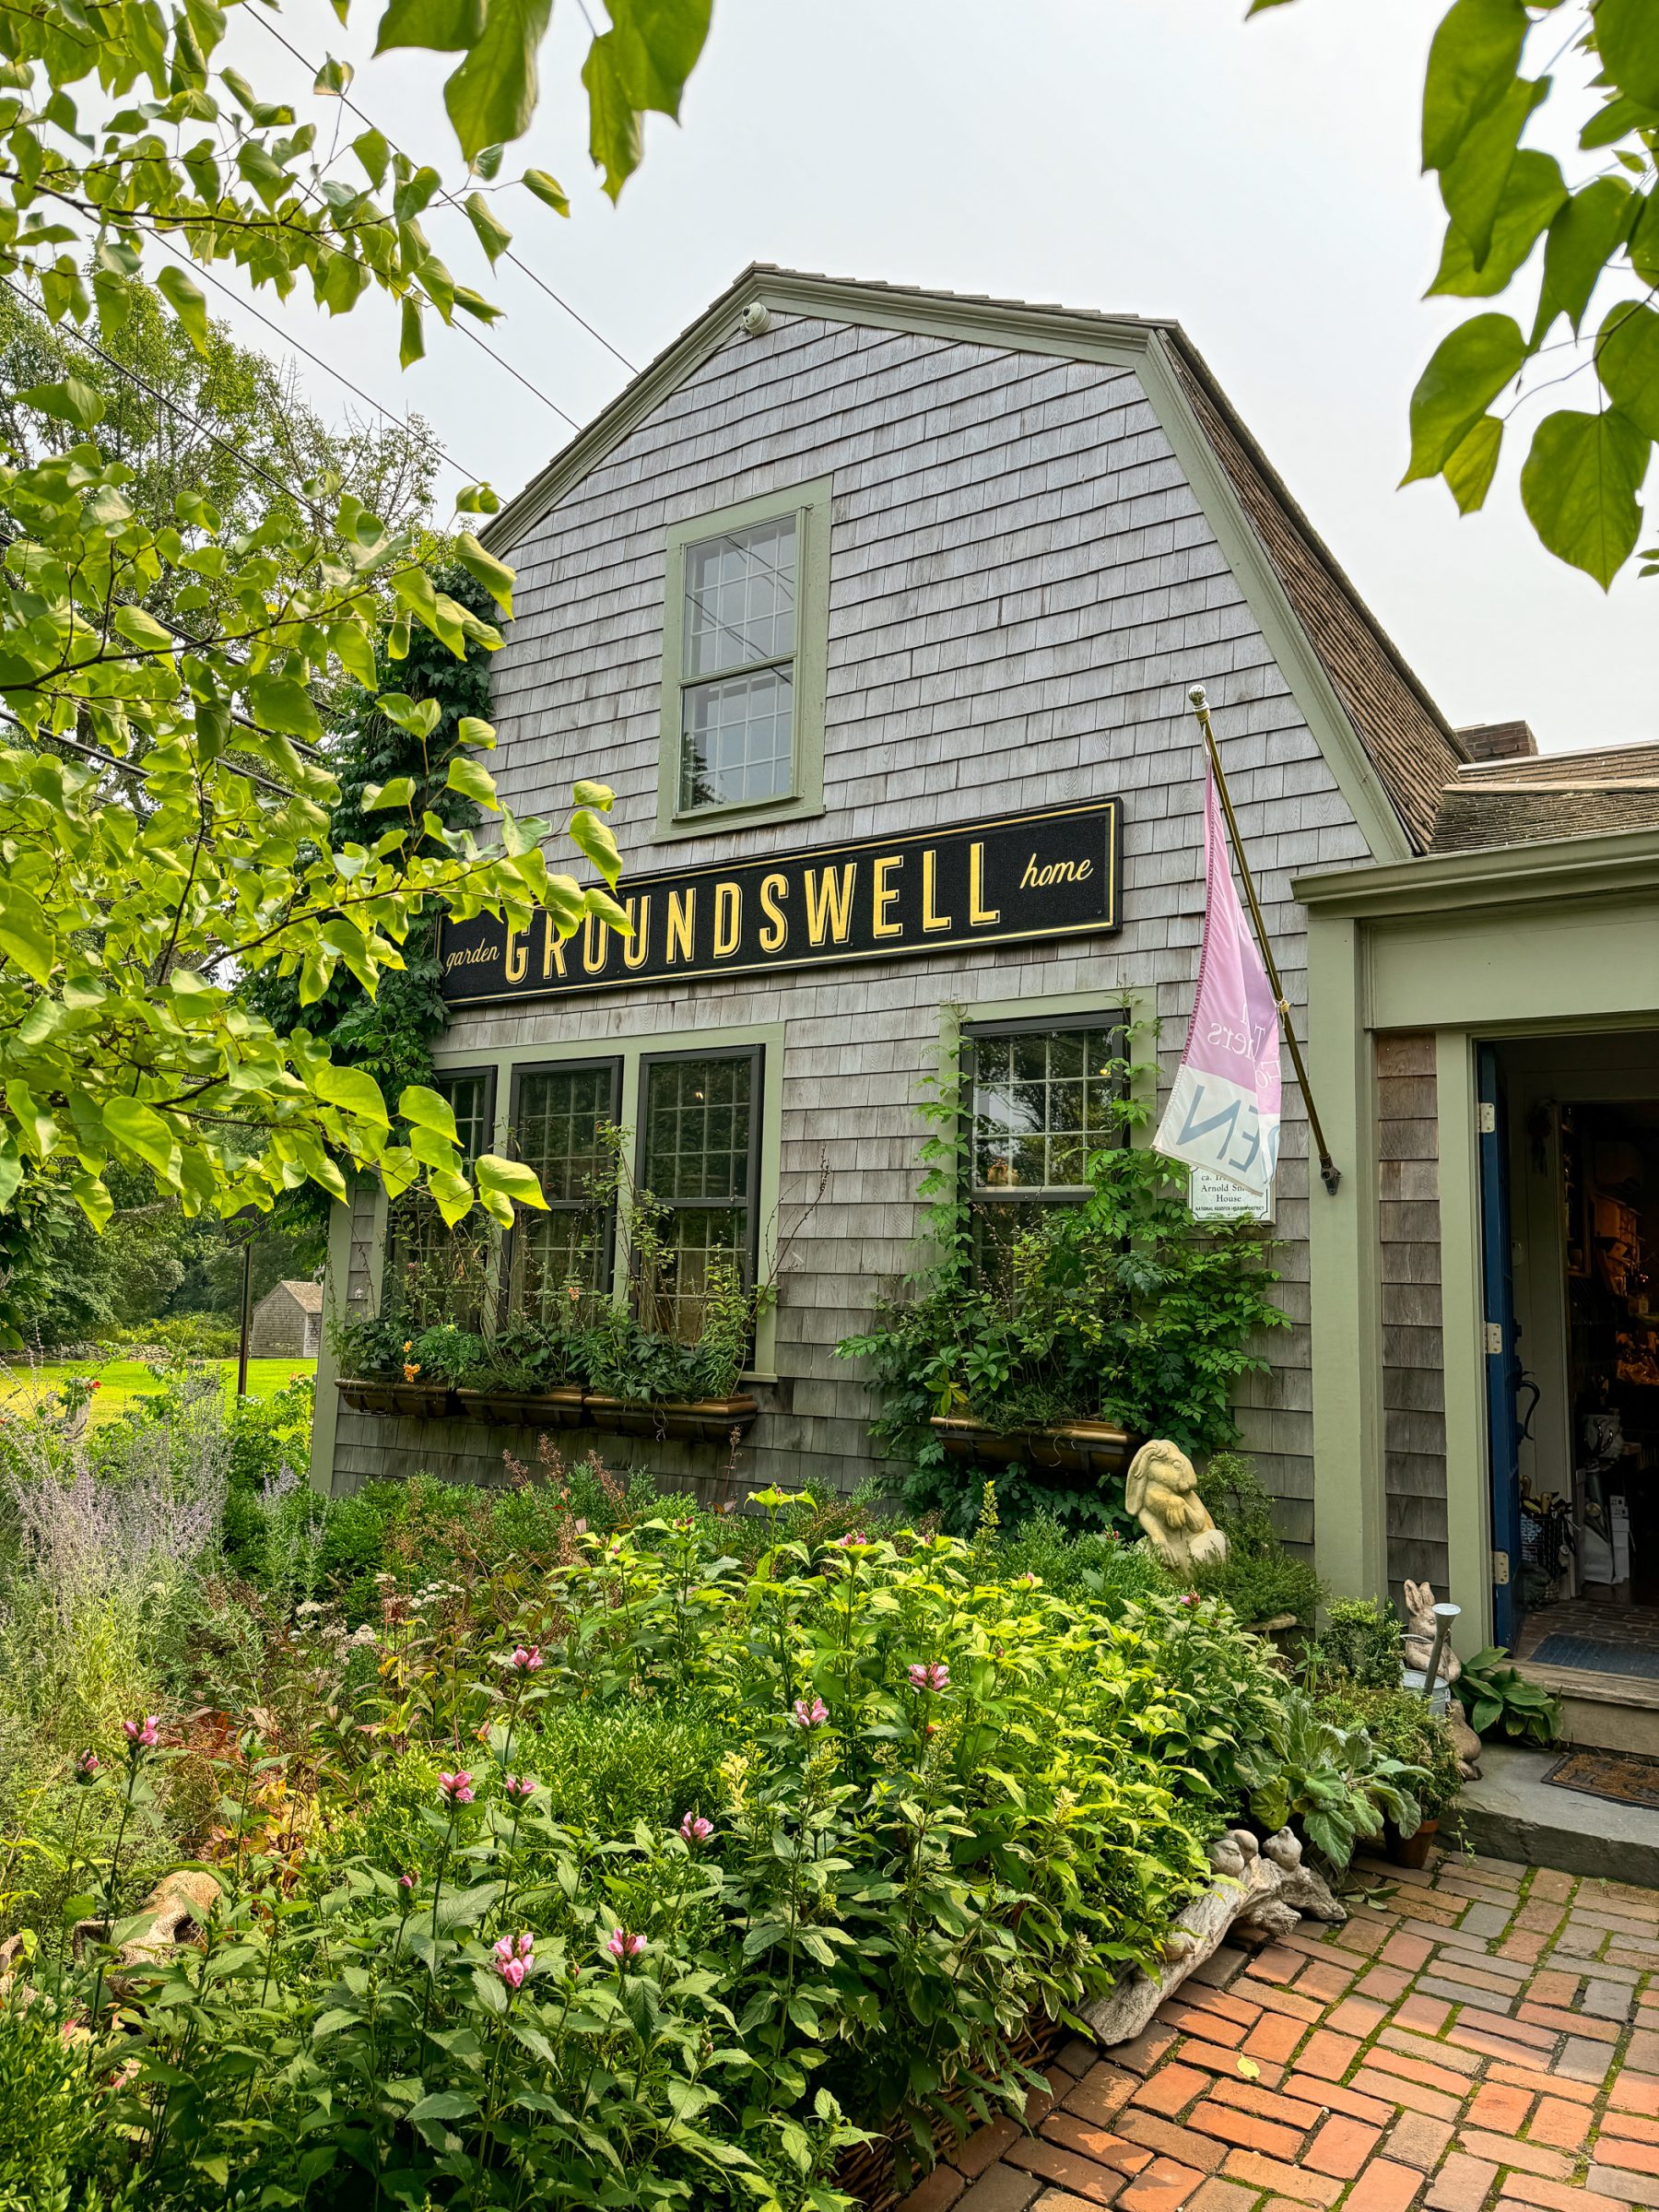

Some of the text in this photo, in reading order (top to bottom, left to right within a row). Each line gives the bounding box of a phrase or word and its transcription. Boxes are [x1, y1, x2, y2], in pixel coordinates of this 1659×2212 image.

[444, 841, 1094, 985] garden GROUNDSWELL home
[1201, 1183, 1229, 1192] Arnold
